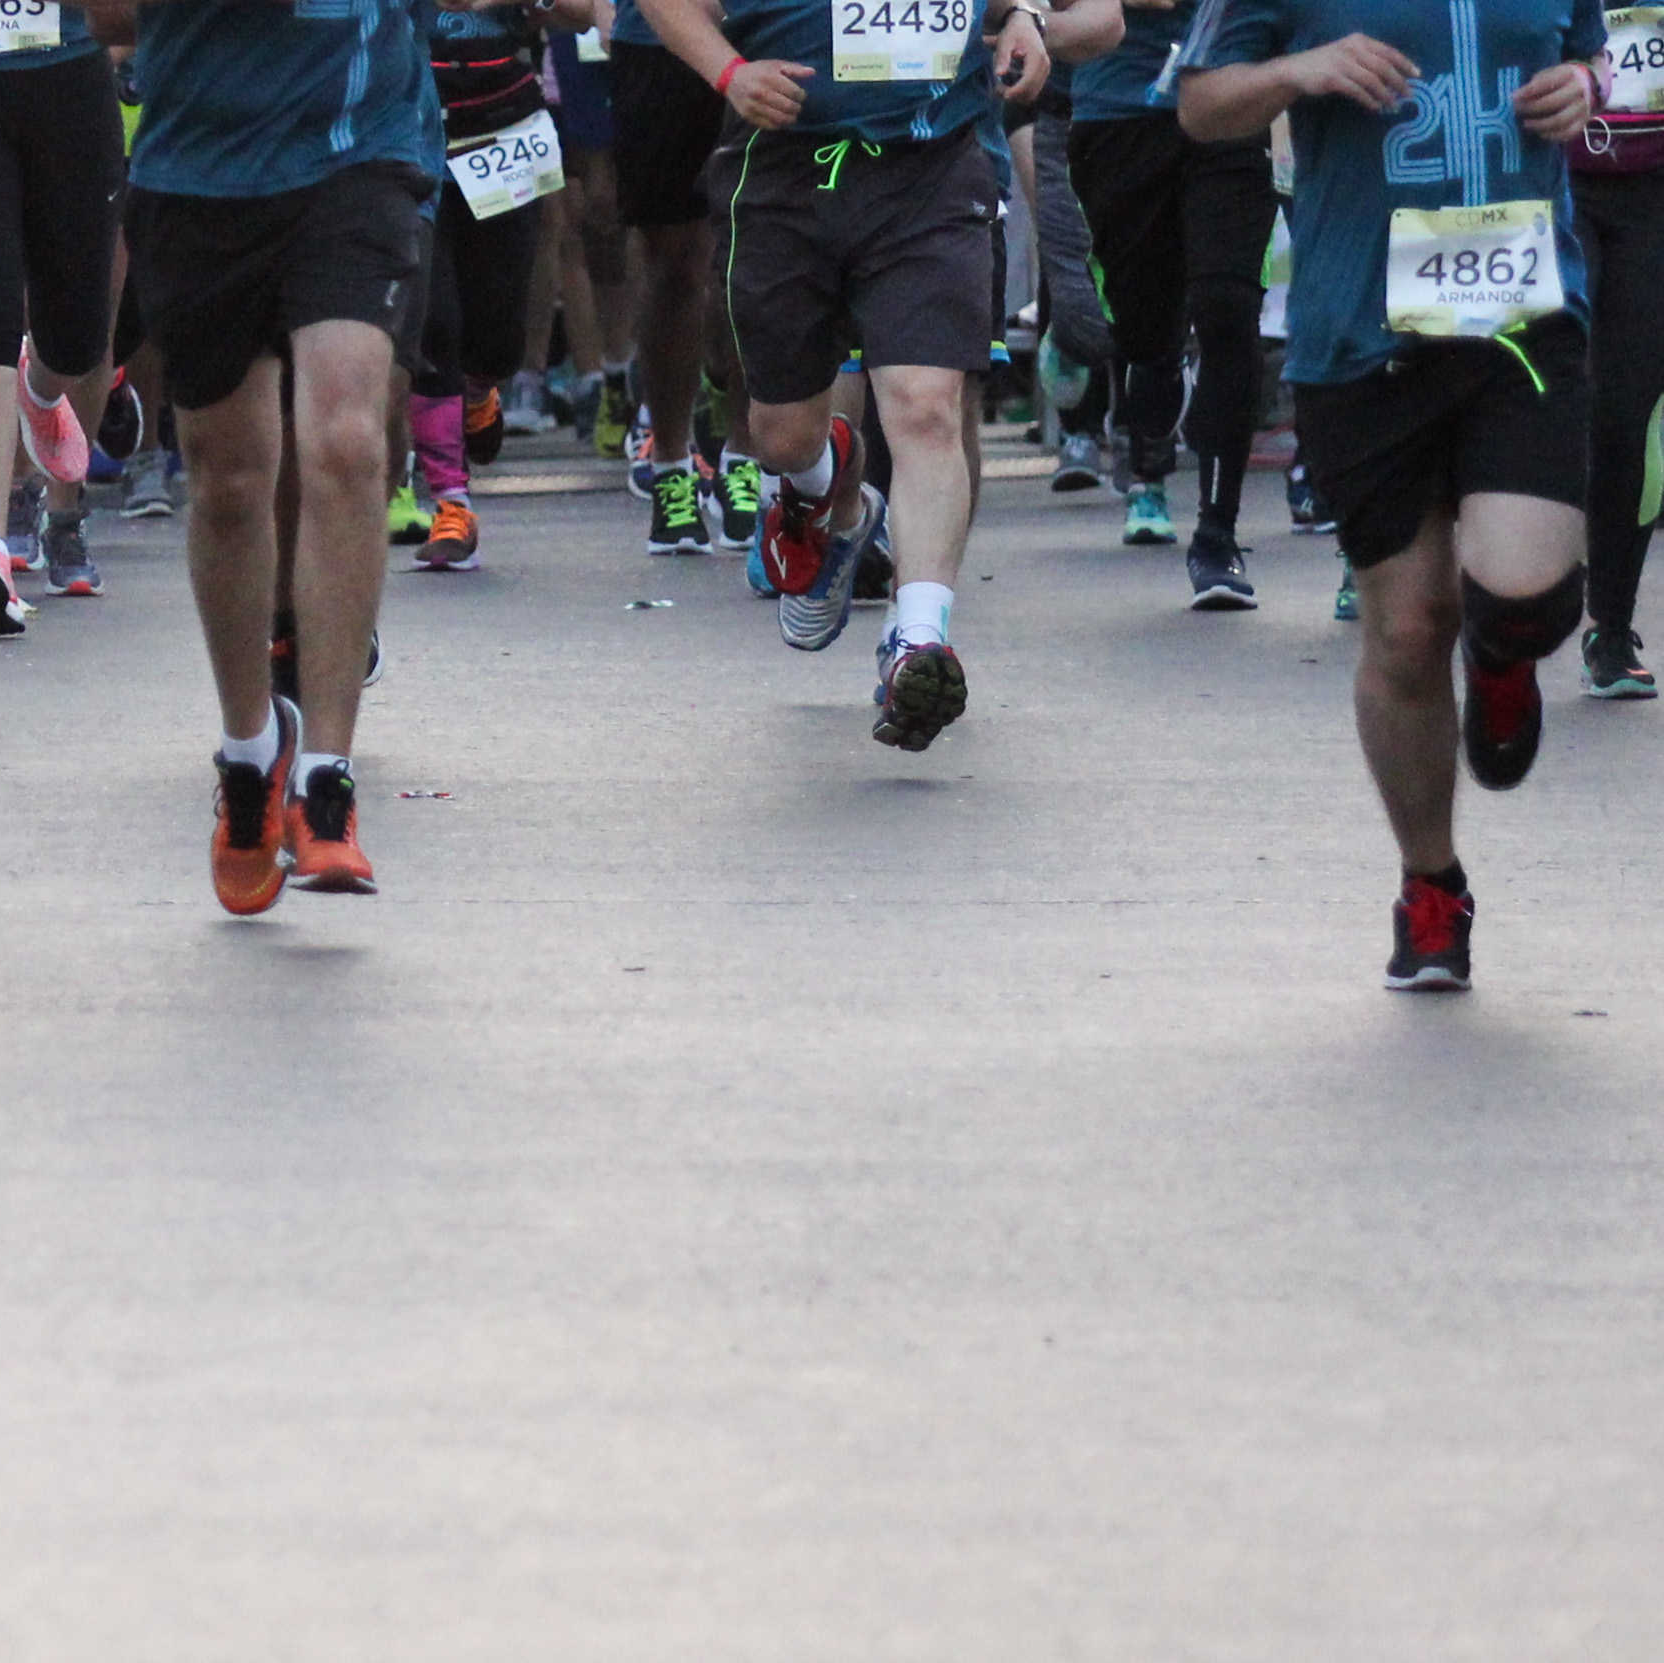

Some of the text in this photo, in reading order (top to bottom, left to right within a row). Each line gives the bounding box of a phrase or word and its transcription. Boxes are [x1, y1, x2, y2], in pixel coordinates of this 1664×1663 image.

[842, 0, 968, 35] 24438
[468, 133, 549, 179] 9246
[1416, 246, 1539, 288] 4862
[1435, 289, 1526, 305] ARMANDO
